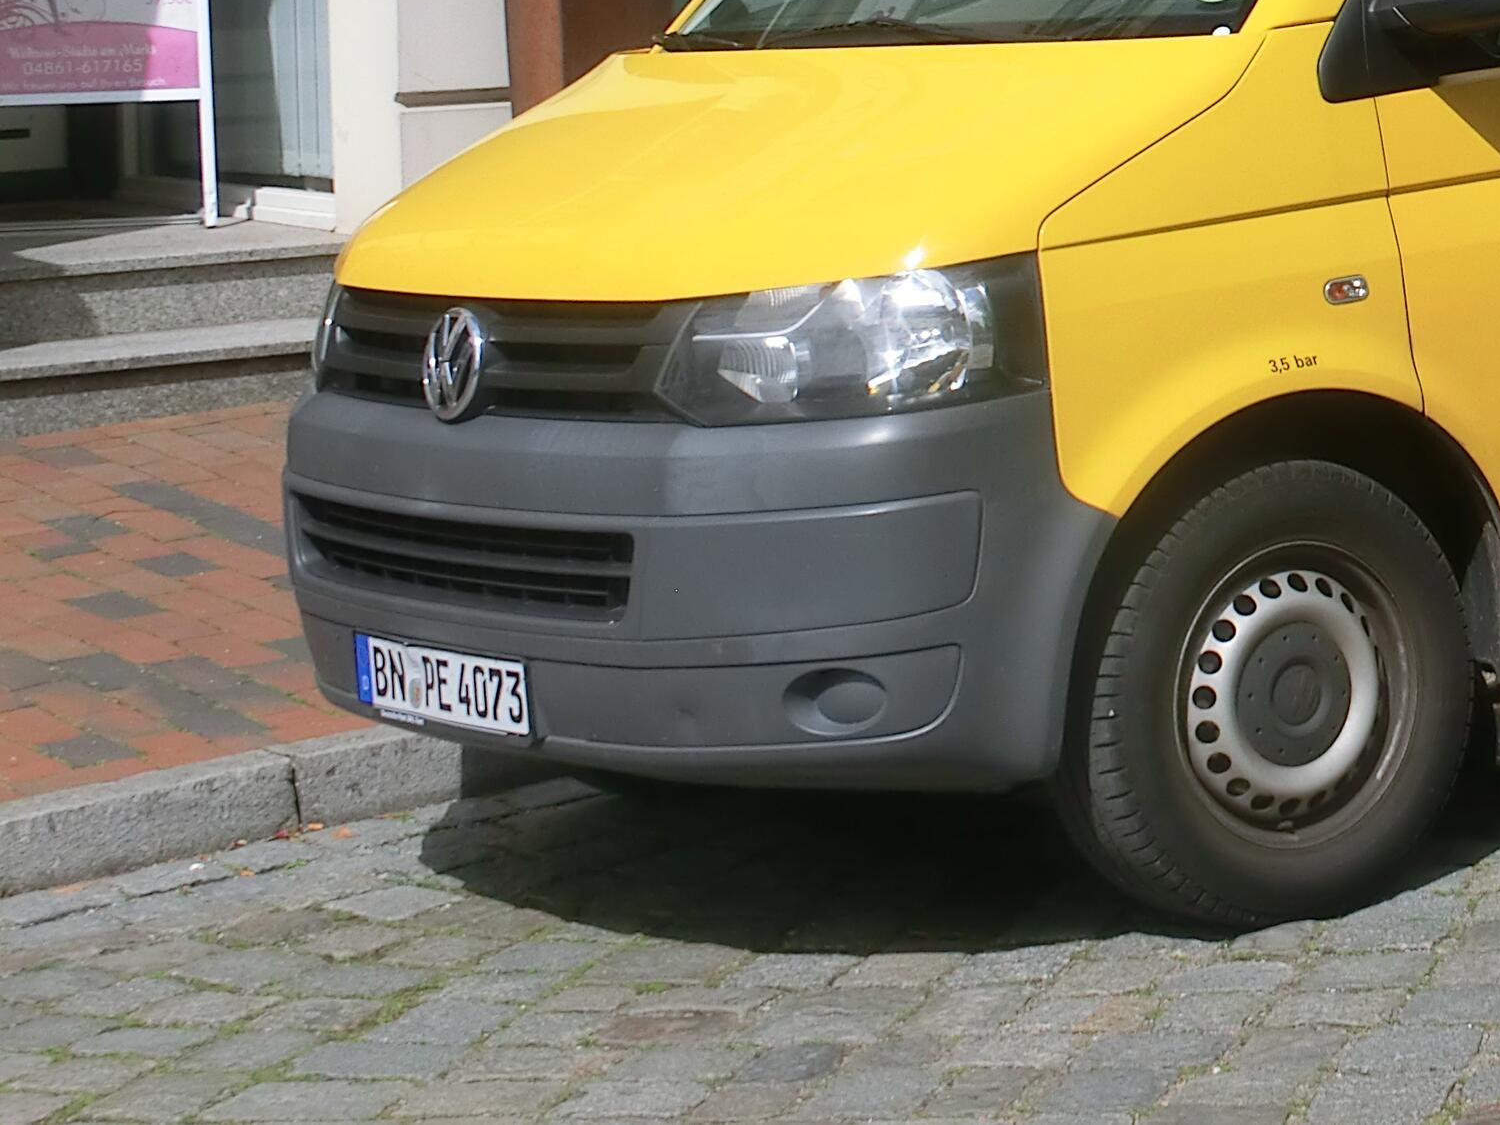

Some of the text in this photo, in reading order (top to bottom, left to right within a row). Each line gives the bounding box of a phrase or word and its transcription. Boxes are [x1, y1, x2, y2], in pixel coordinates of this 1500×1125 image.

[23, 59, 143, 75] 04861-617165
[1268, 354, 1318, 374] 3,5 bar
[373, 646, 406, 702] BN
